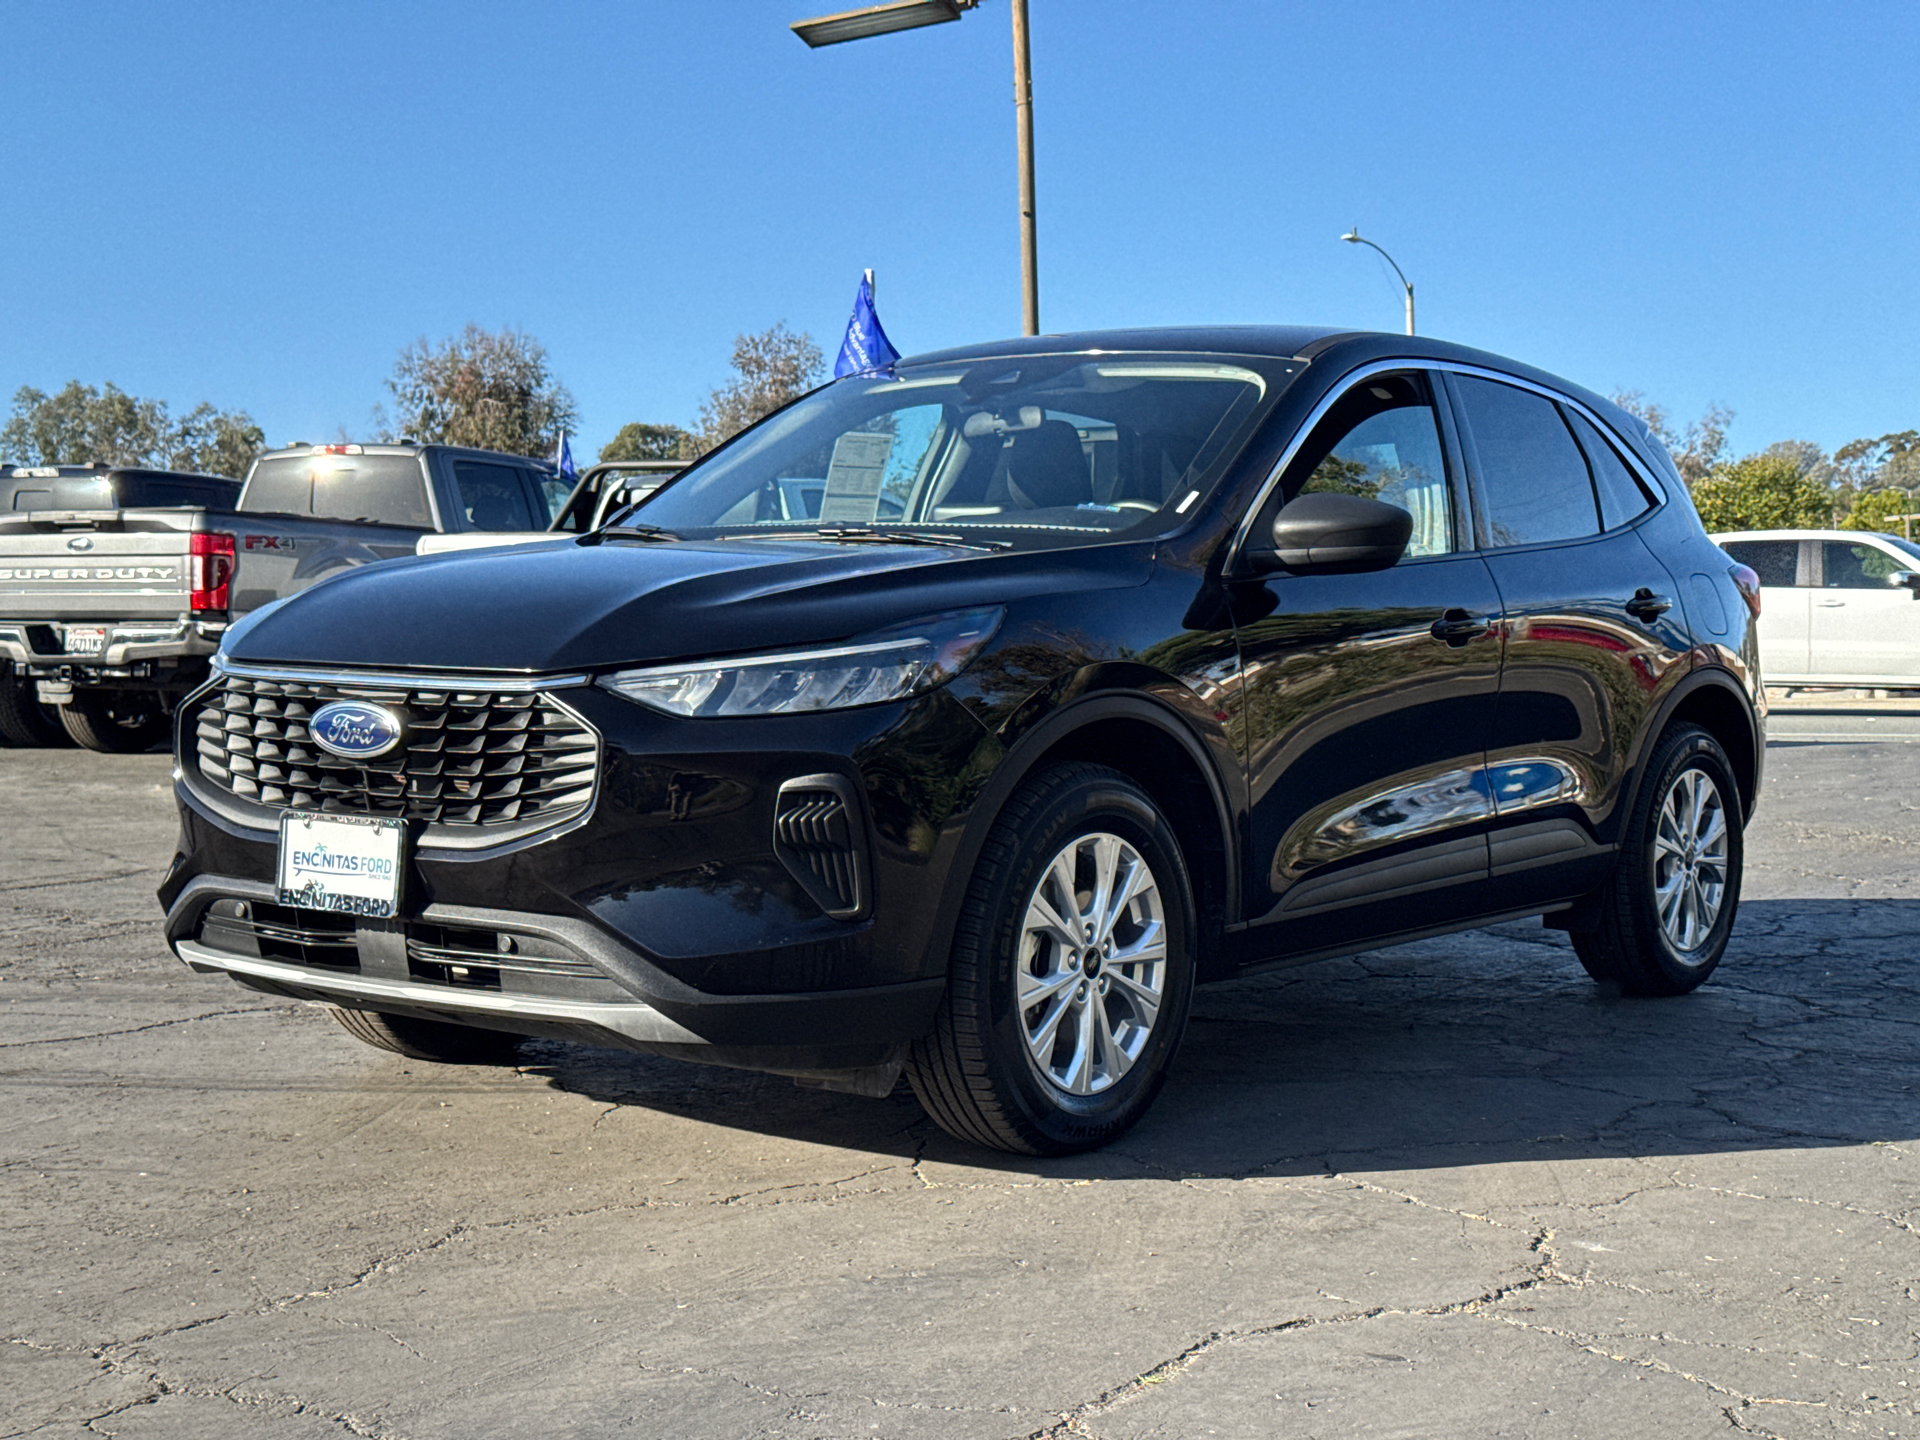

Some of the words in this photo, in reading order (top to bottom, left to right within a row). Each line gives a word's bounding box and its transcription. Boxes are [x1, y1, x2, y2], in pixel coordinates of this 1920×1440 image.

[245, 534, 297, 550] FX4
[0, 568, 88, 579] SUPER
[95, 567, 173, 579] DUTY
[327, 712, 377, 745] Ford
[1032, 811, 1068, 855] SUV
[293, 850, 359, 871] ENCINITAS
[360, 856, 392, 874] FORD
[279, 888, 353, 912] ENCINITAS
[353, 897, 390, 917] FORD
